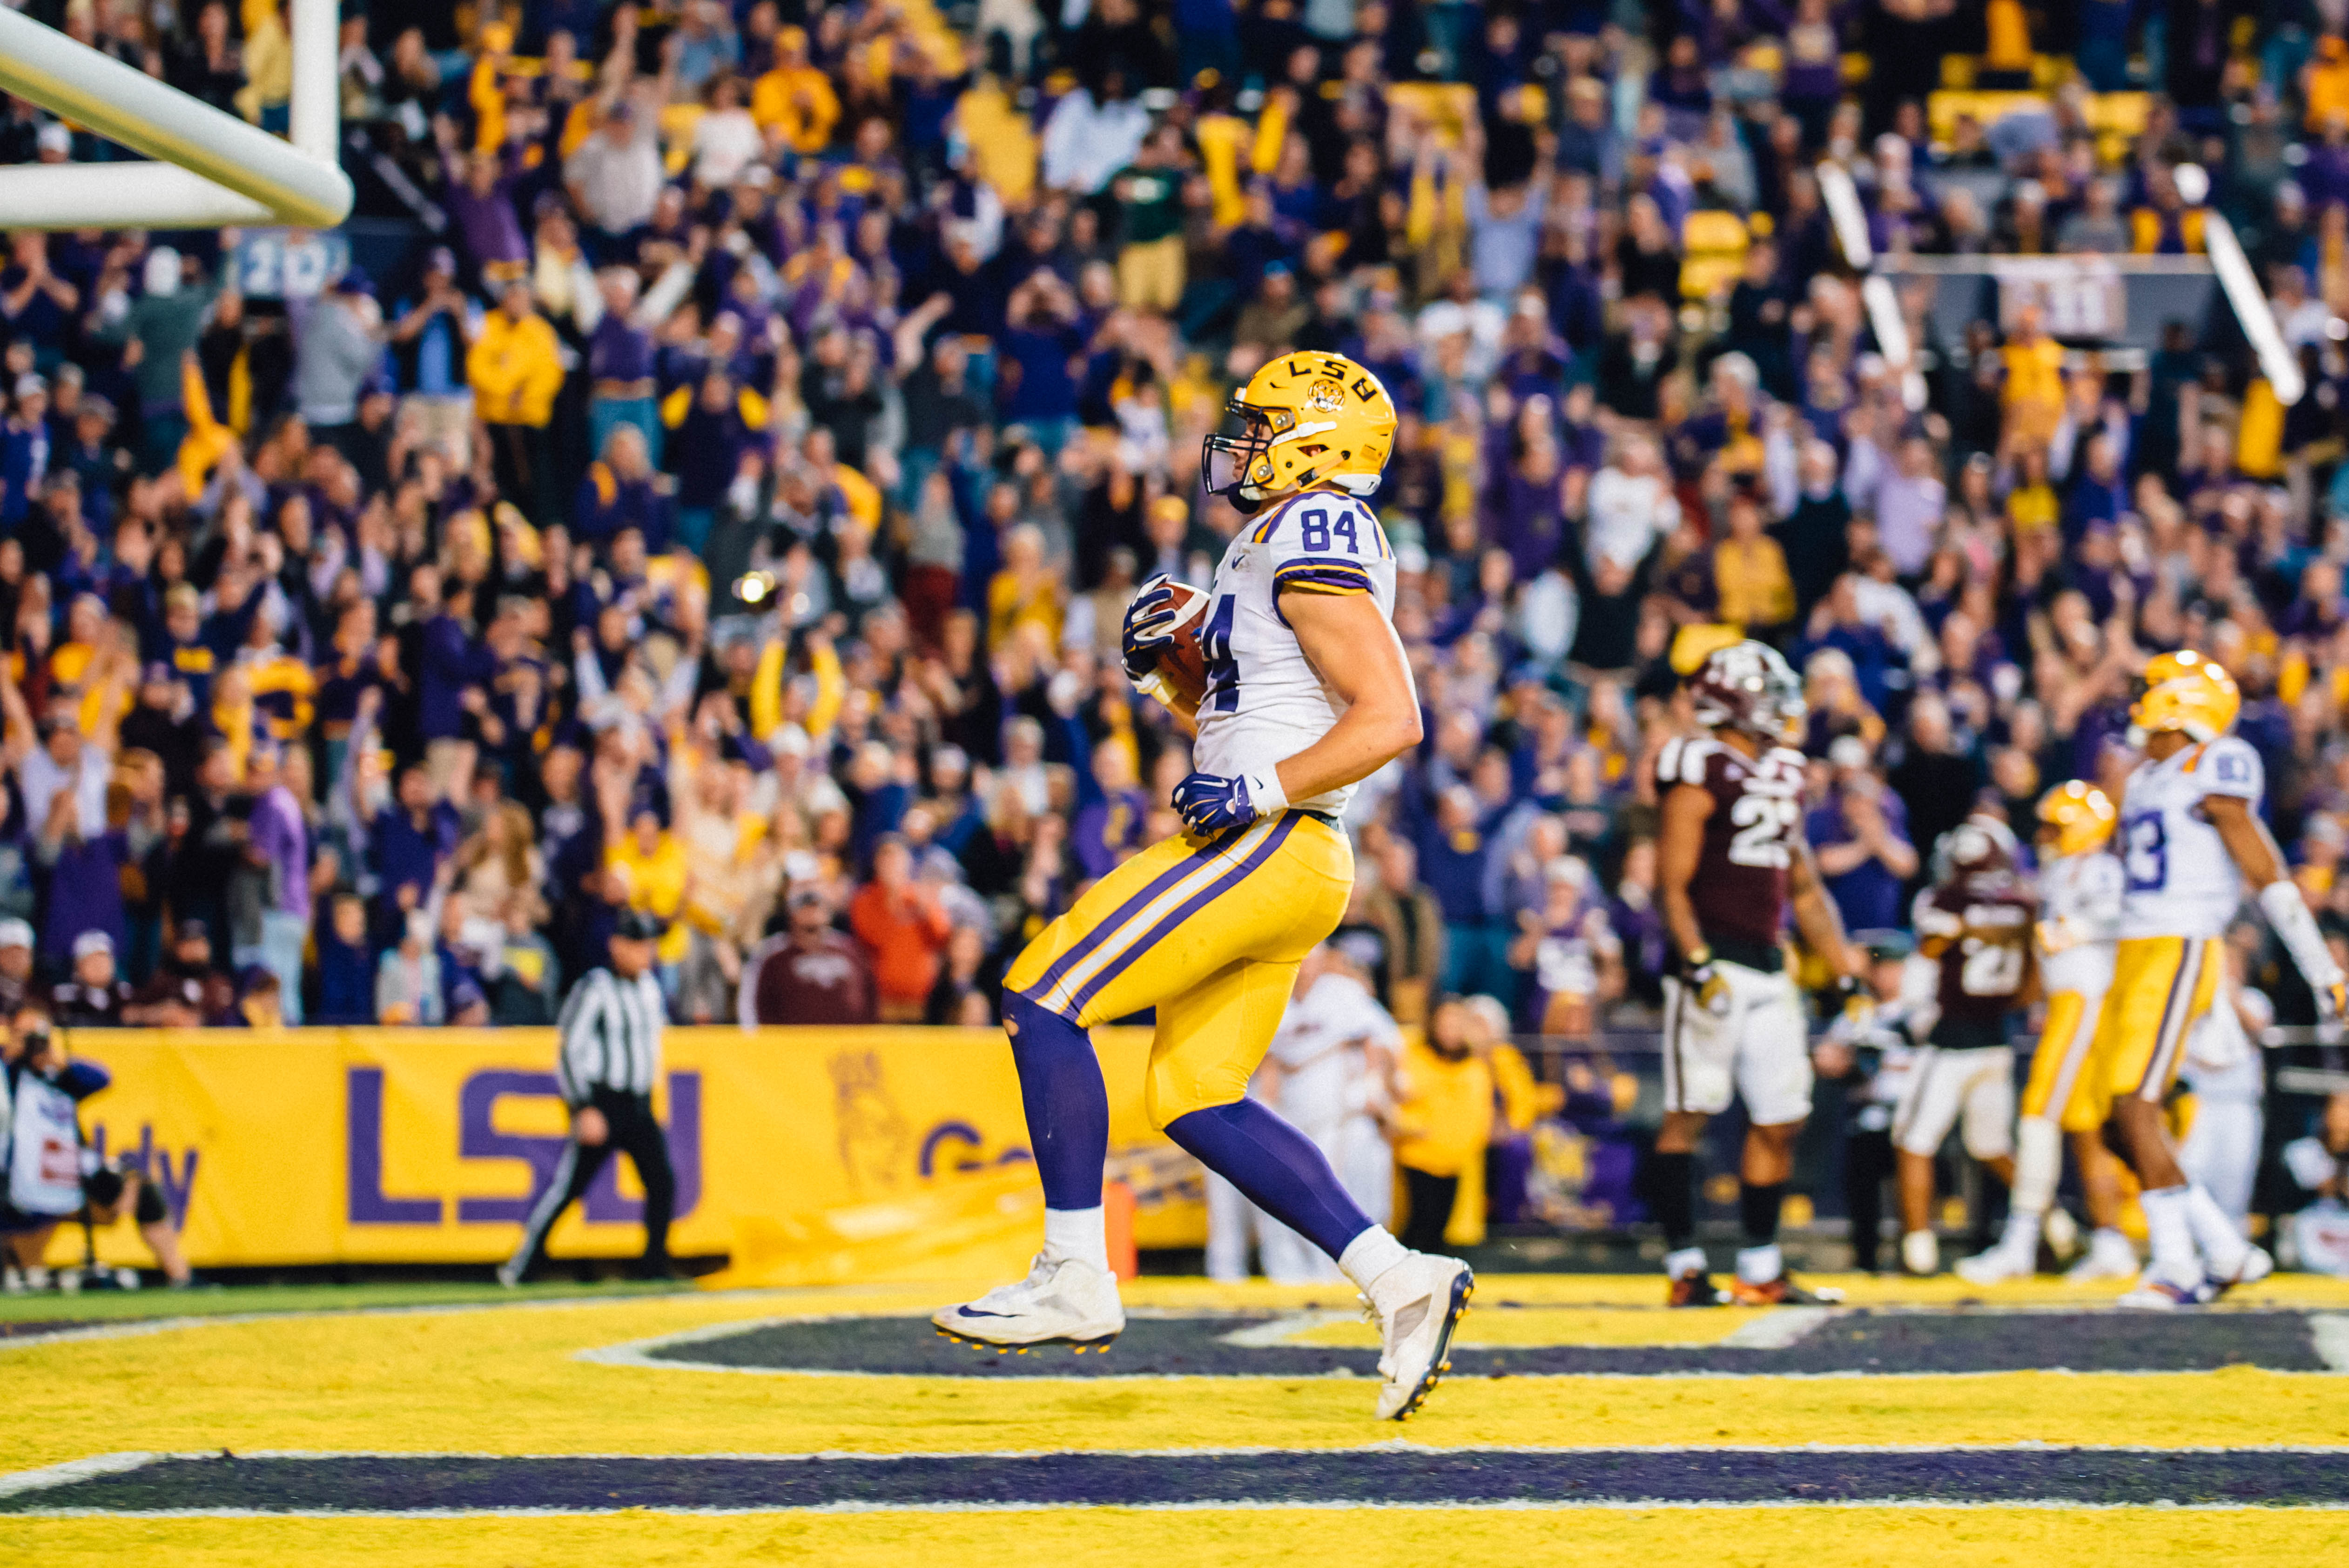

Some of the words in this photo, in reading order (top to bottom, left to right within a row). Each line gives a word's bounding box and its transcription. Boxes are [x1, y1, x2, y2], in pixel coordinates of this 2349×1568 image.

[1288, 360, 1378, 403] LSU
[1301, 509, 1359, 554] 84
[347, 1068, 701, 1225] LSU
